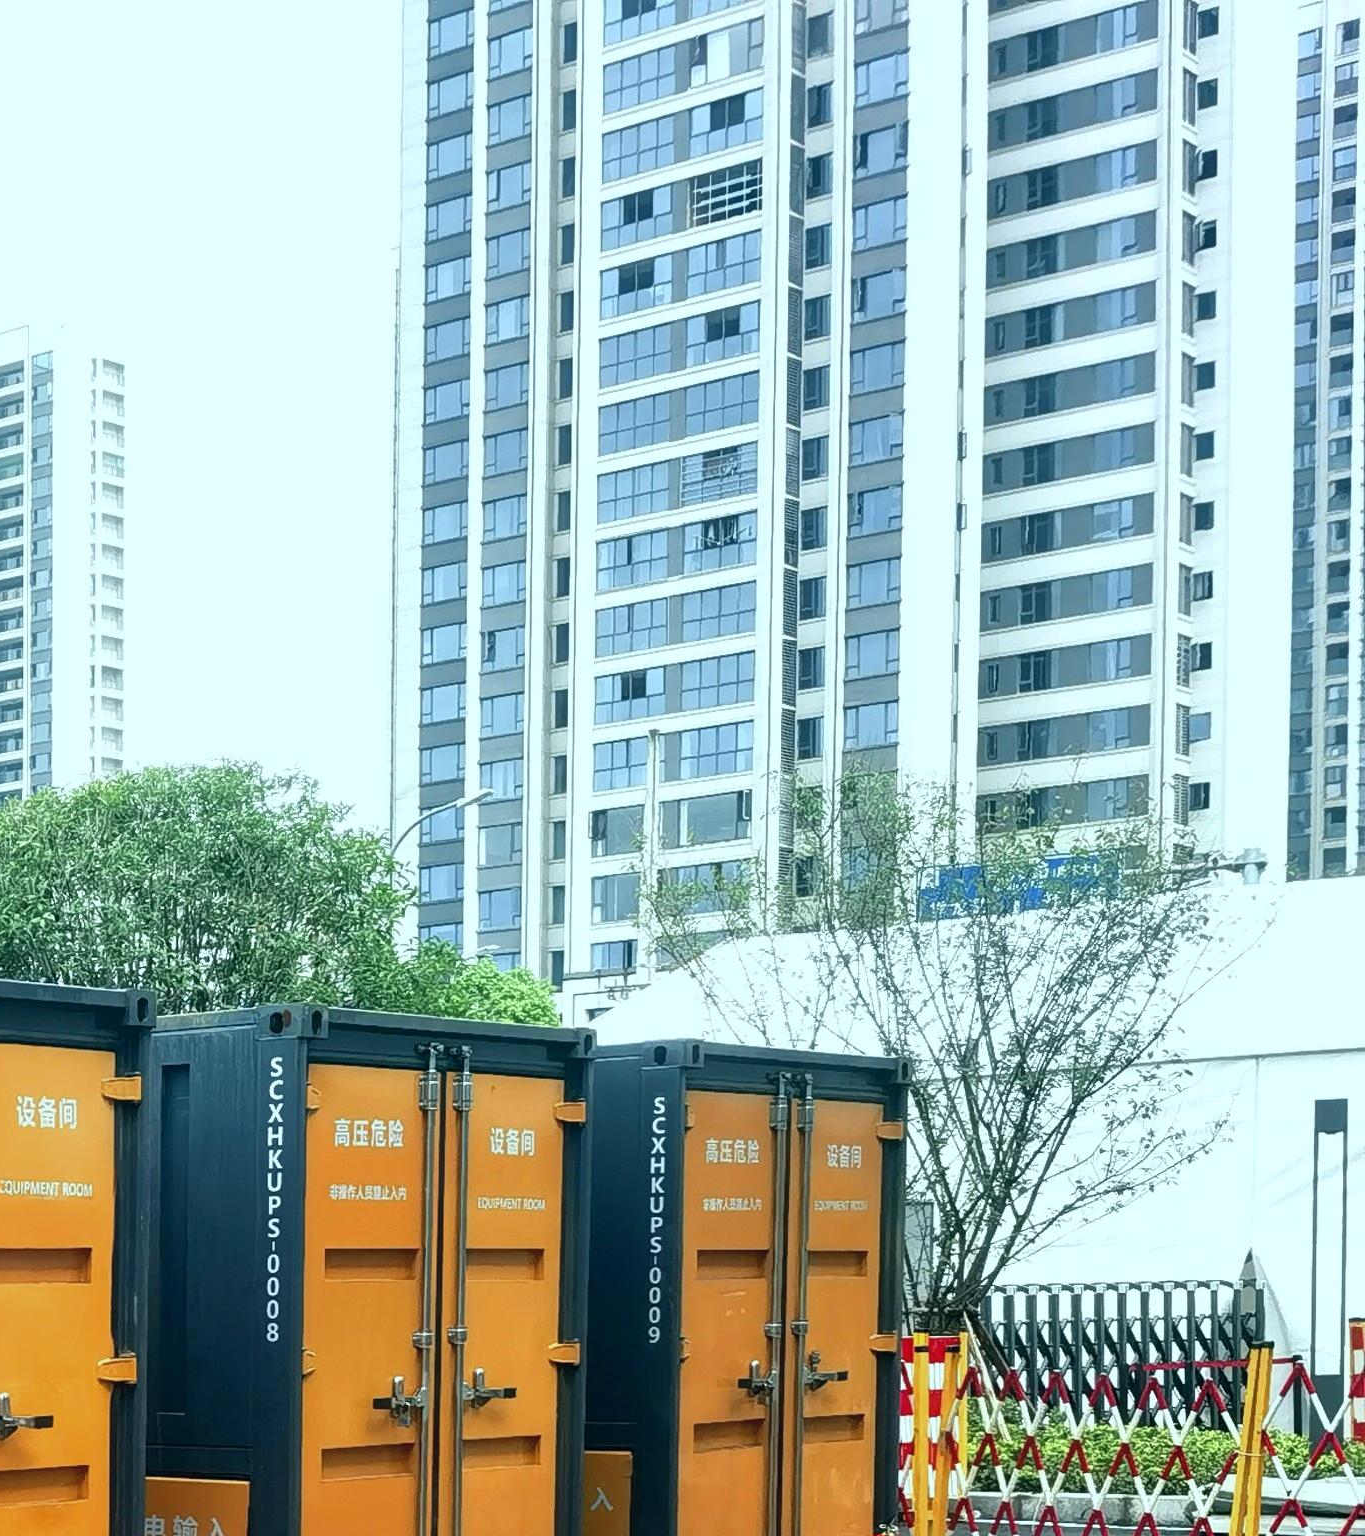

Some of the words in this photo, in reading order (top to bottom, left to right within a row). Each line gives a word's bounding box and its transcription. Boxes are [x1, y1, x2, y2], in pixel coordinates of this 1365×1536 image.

[16, 1095, 79, 1129] 设备间
[333, 1118, 405, 1148] 高压危险
[489, 1127, 536, 1156] 设备间
[705, 1138, 760, 1164] 高压危险
[826, 1144, 862, 1168] 设备间
[62, 1181, 93, 1197] ROOM
